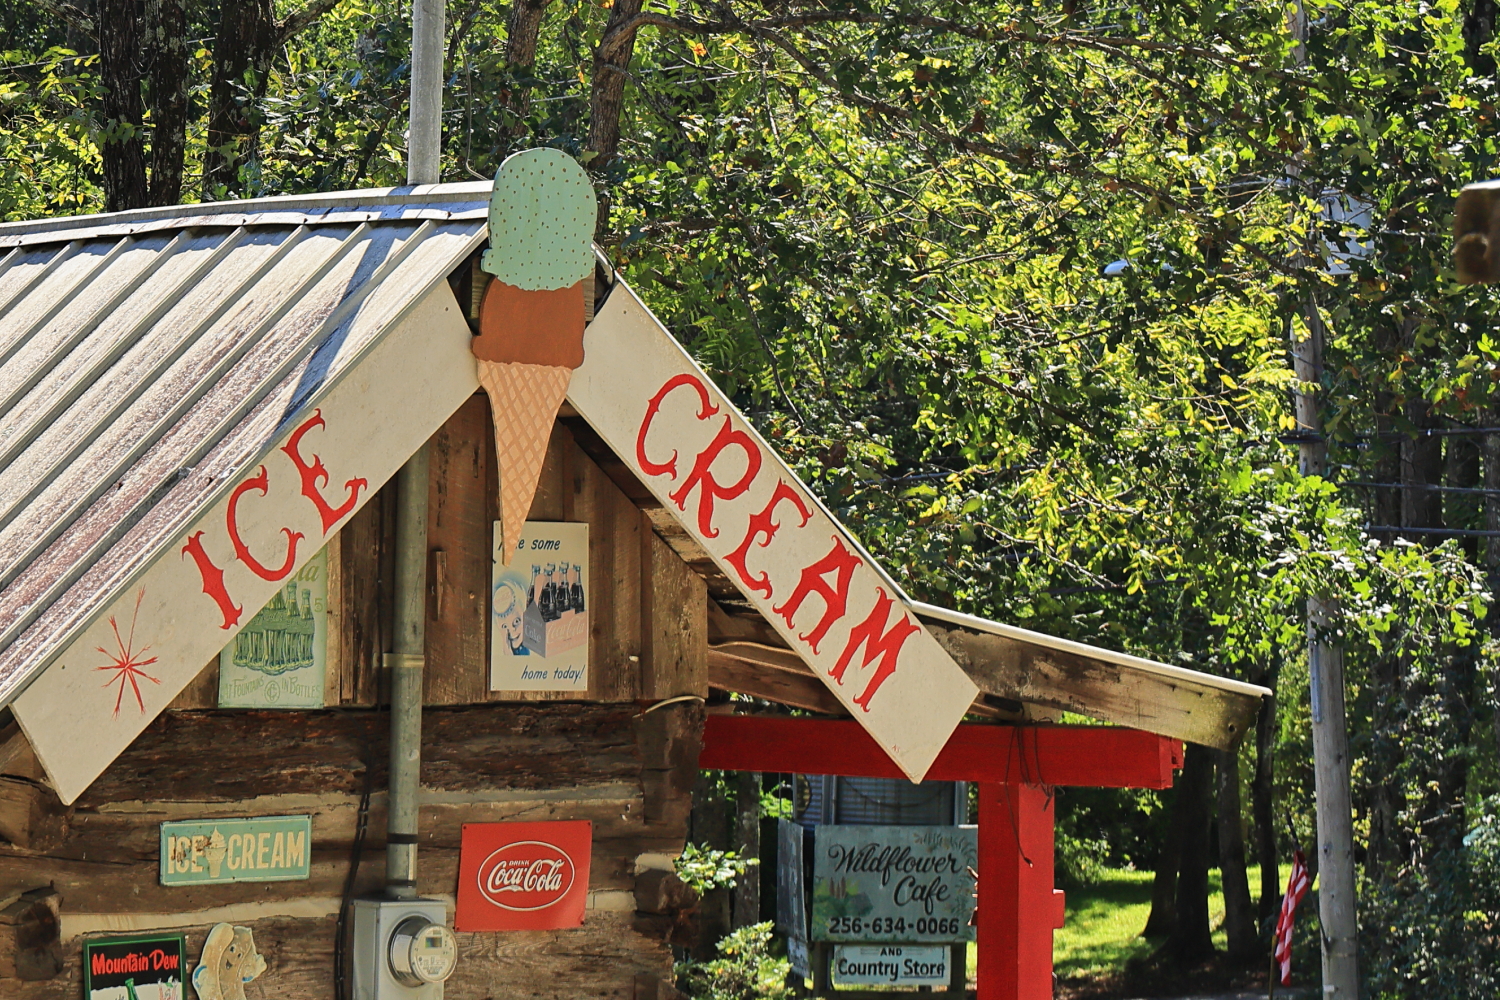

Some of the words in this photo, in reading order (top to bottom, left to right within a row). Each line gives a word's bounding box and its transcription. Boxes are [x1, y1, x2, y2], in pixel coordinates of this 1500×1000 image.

[181, 407, 369, 631] ICE
[530, 538, 561, 551] some
[635, 372, 922, 714] CREAM
[520, 664, 548, 681] home
[553, 663, 586, 685] today!
[167, 834, 206, 875] ICE
[226, 830, 305, 871] CREAM
[508, 859, 531, 867] DRINK
[827, 842, 963, 887] Wildflower
[486, 858, 566, 895] Coca-Cola
[893, 875, 951, 916] Cafe
[828, 916, 960, 935] 256-634-0066
[92, 952, 149, 976] Mountain
[149, 948, 179, 971] Dew
[880, 947, 903, 957] AND
[837, 958, 899, 982] Country
[903, 958, 945, 977] Store
